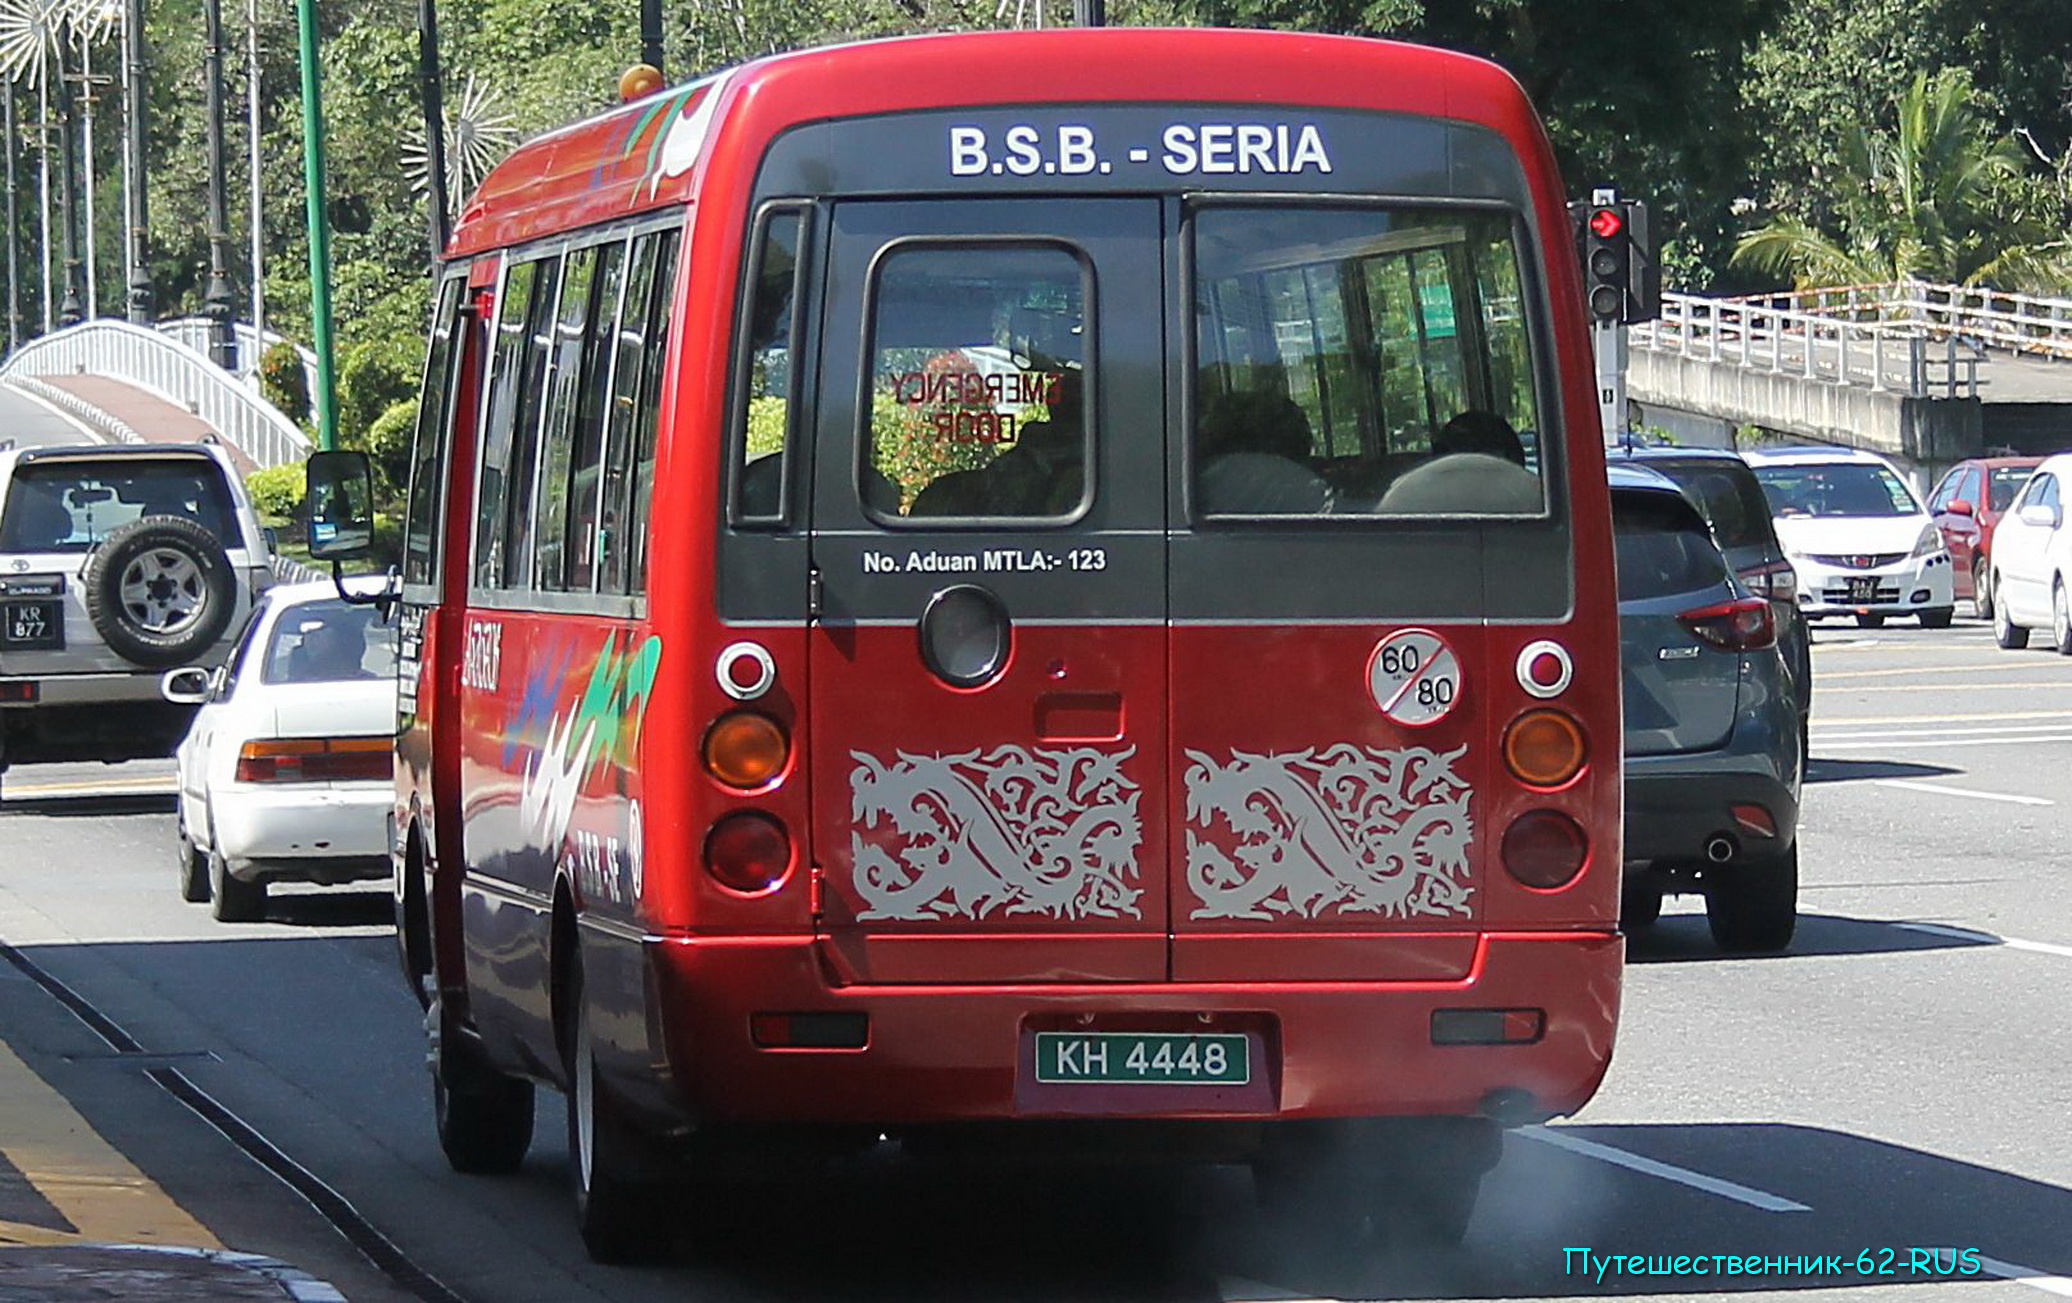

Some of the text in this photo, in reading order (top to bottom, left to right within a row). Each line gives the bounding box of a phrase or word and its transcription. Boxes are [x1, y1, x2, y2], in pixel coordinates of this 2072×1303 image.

[950, 124, 1333, 176] B.S.B. - SERIA
[863, 549, 1106, 573] No. Aduan MTLA:- 123
[20, 606, 41, 621] KR
[15, 621, 45, 637] 877
[1381, 645, 1420, 674] 60
[1417, 677, 1453, 706] 80
[1057, 1040, 1228, 1076] KH 4448
